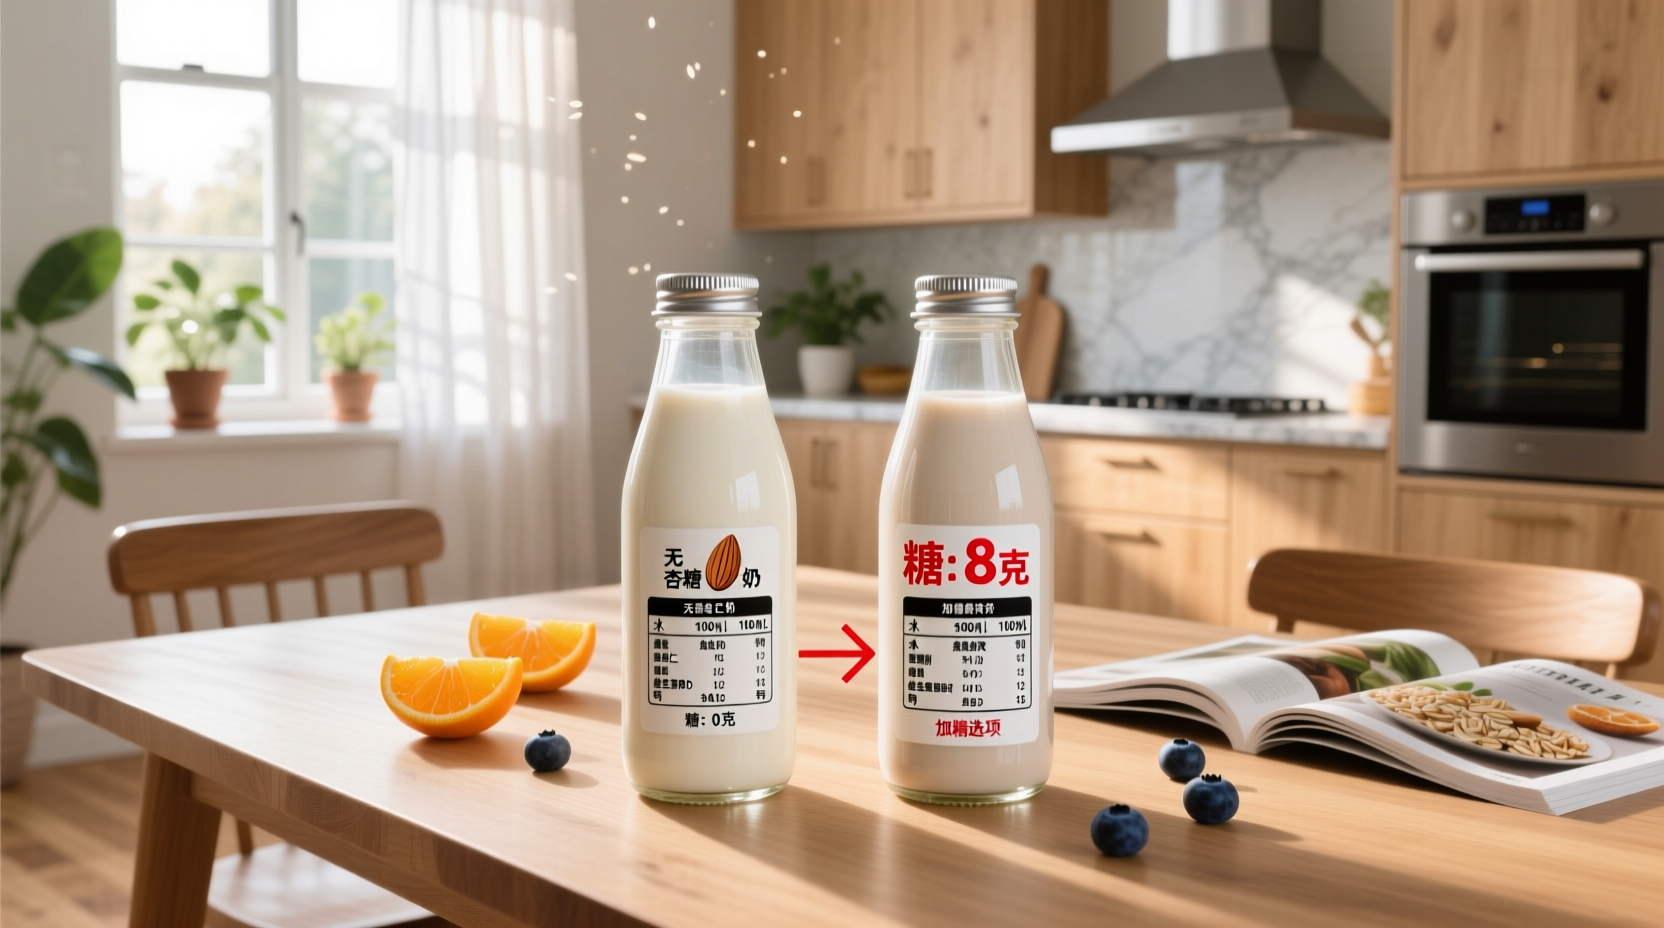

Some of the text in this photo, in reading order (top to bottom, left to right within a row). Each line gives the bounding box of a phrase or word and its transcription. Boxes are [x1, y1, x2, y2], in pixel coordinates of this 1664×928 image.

[664, 548, 683, 567] 无
[903, 537, 1030, 587] 糖:8克
[664, 567, 761, 589] 杏糖 奶
